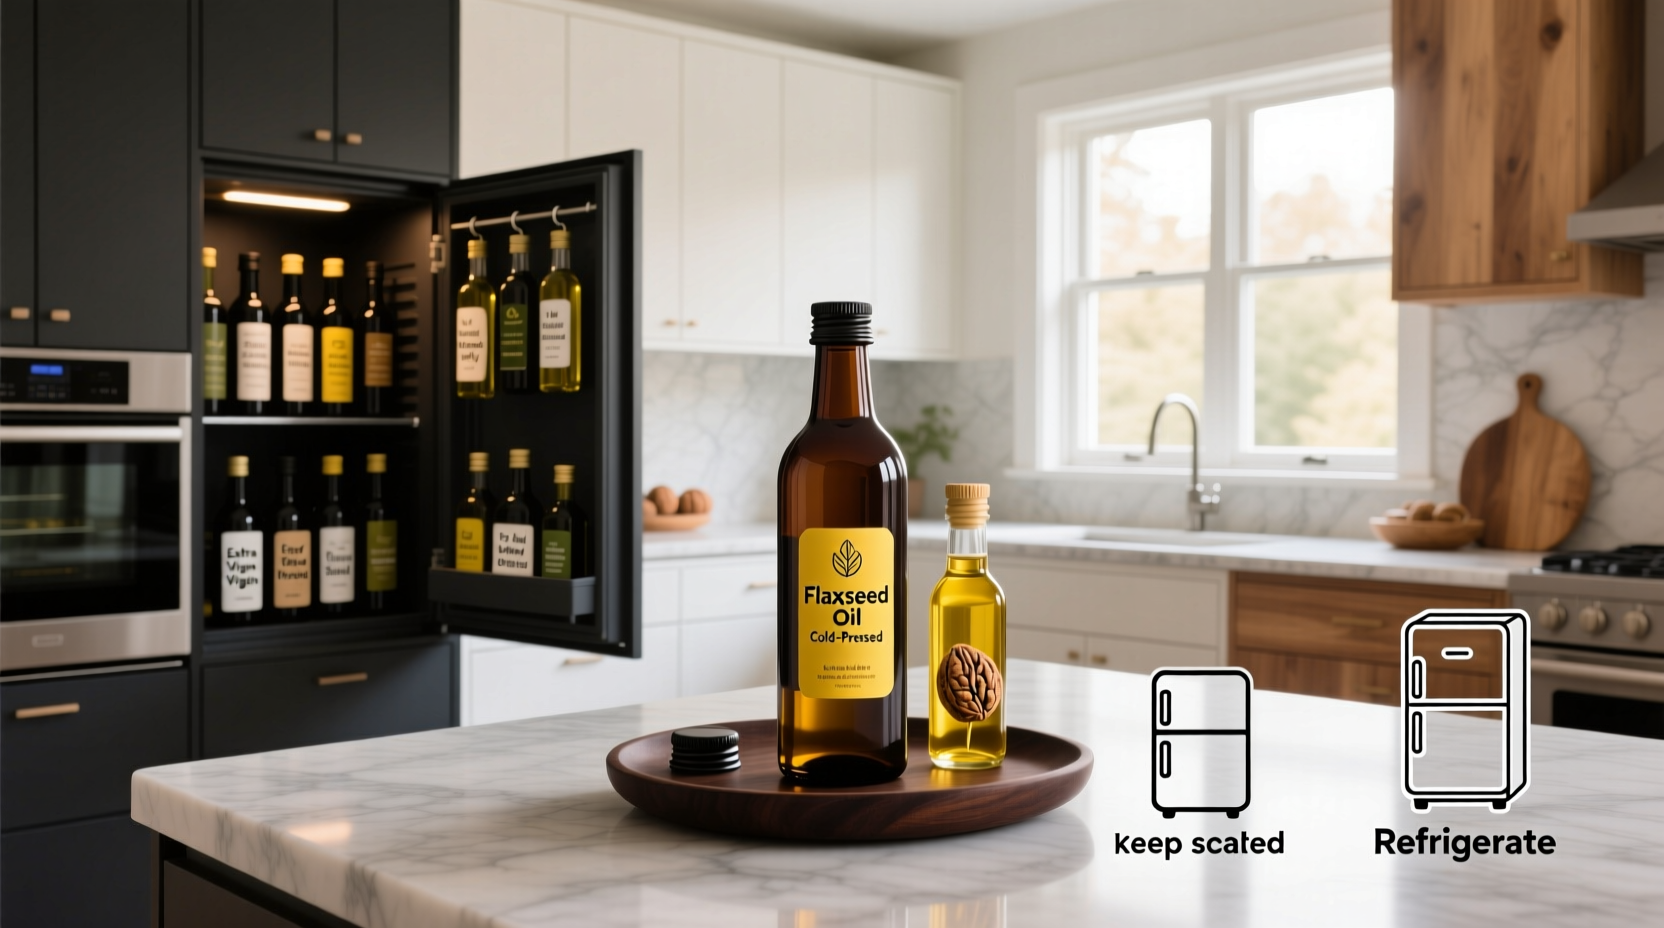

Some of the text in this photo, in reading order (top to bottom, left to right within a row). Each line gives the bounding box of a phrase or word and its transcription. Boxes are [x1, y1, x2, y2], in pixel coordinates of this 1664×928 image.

[227, 547, 257, 558] Extra
[804, 585, 888, 605] Flaxseed
[833, 607, 861, 626] Oil
